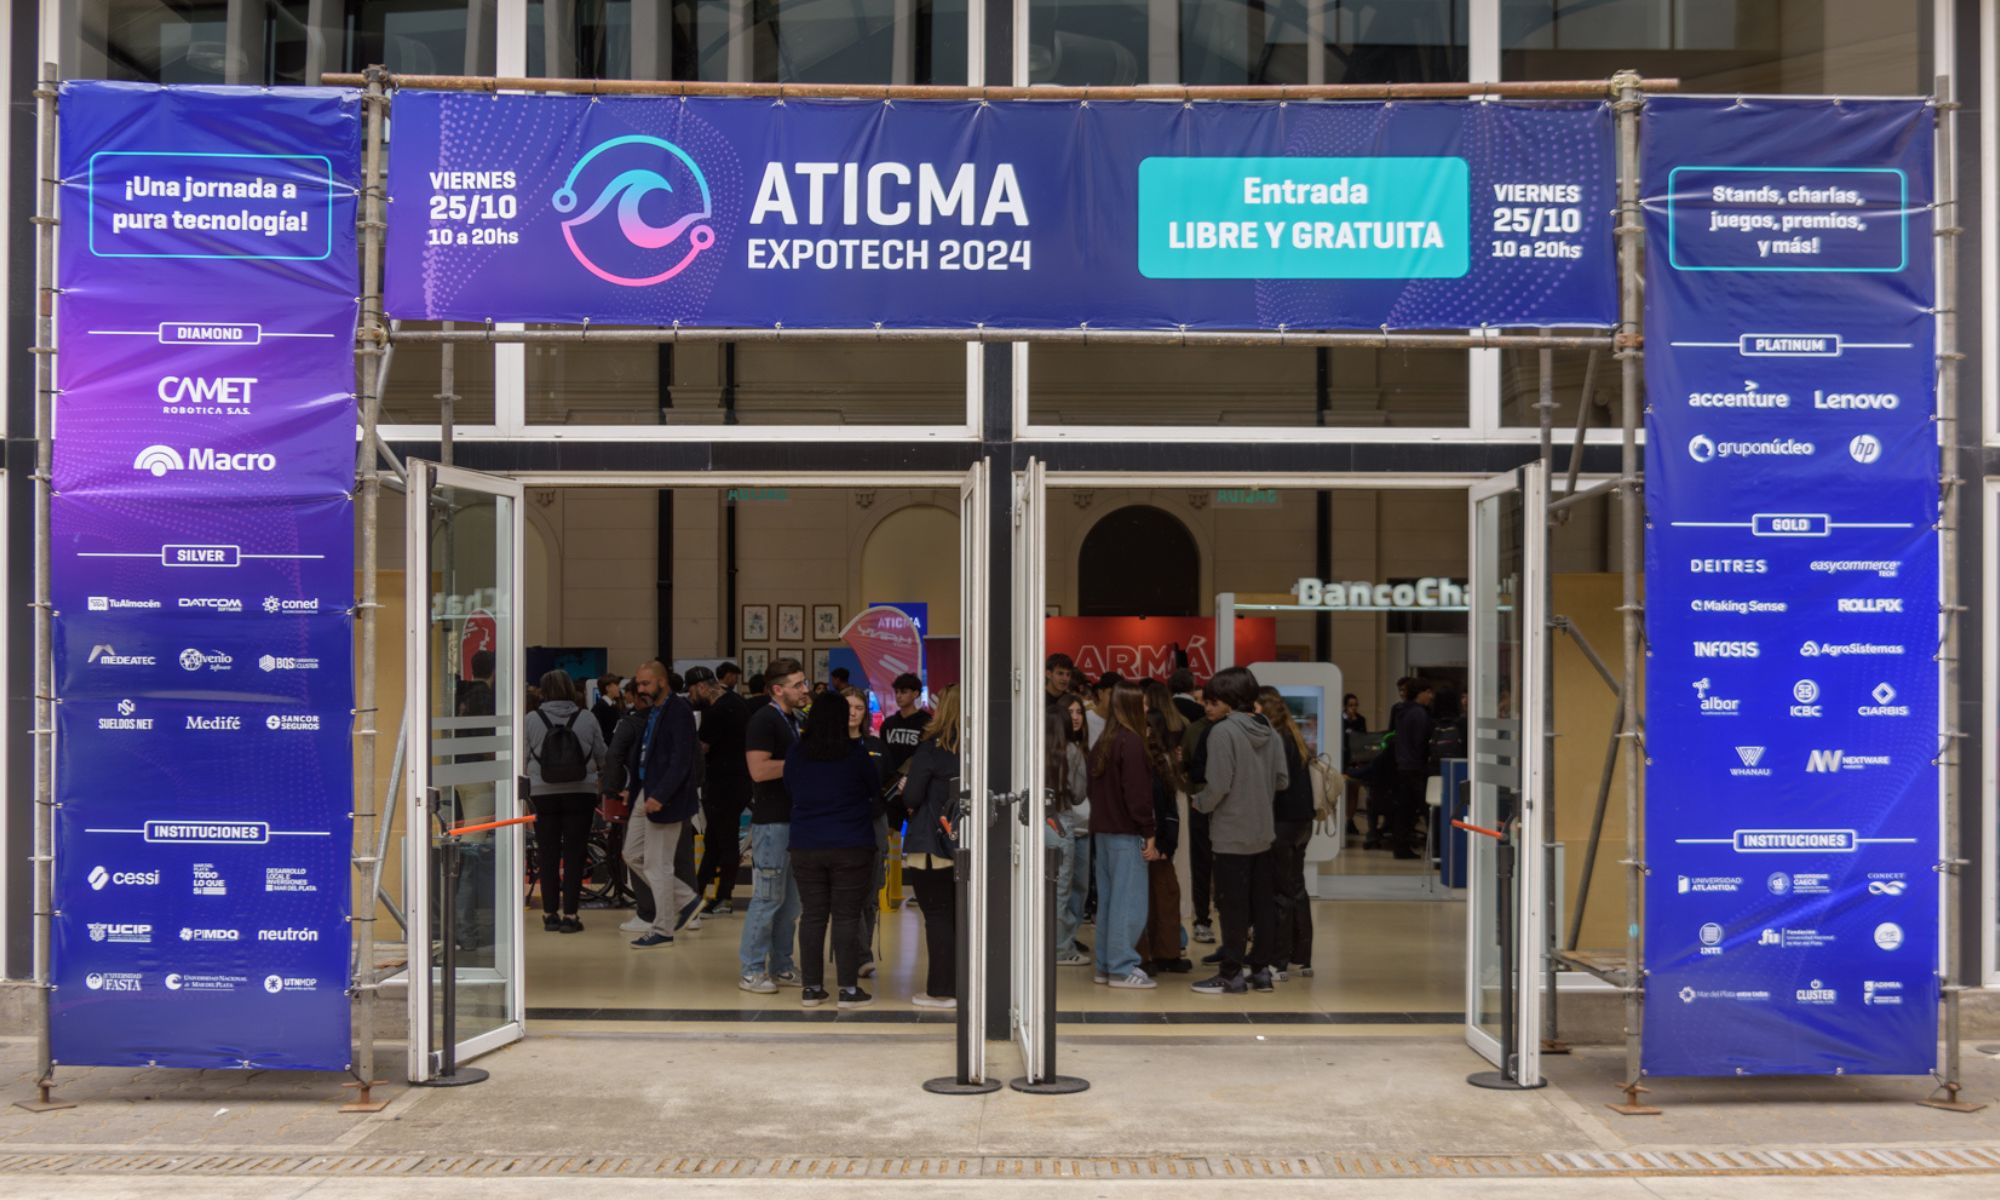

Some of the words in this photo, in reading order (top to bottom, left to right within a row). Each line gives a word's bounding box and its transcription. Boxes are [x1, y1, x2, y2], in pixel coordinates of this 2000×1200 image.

[429, 171, 517, 190] VIERNES
[125, 176, 181, 200] ¡Una
[183, 177, 278, 202] jornada
[282, 182, 297, 199] a
[749, 161, 1030, 226] ATICMA
[1244, 176, 1369, 205] Entrada
[1494, 184, 1581, 203] VIERNES
[1712, 185, 1787, 205] Stands,
[1788, 185, 1866, 206] charlas,
[429, 194, 518, 223] 25/10
[113, 213, 168, 234] pura
[172, 210, 308, 236] tecnología!
[1492, 208, 1581, 237] 25/10
[1709, 210, 1781, 232] juegos,
[1782, 212, 1867, 232] premios,
[428, 229, 453, 245] 10
[456, 232, 468, 245] a
[471, 228, 519, 245] 20hs
[1169, 221, 1258, 249] LIBRE
[1264, 221, 1286, 249] Y
[1291, 221, 1444, 249] GRATUITA
[1491, 242, 1516, 258] 10
[1519, 245, 1531, 258] a
[1533, 241, 1582, 258] 20hs
[1757, 240, 1771, 257] y
[1772, 236, 1820, 254] más!
[748, 239, 929, 270] EXPOTECH
[940, 239, 1032, 271] 2024
[177, 327, 242, 341] DIAMOND
[1756, 339, 1826, 351] PLATINUM
[158, 377, 258, 404] CAMET
[1689, 389, 1790, 408] accenture
[1814, 390, 1899, 409] Lenovo
[163, 406, 222, 415] ROBOTICA
[1718, 438, 1815, 457] gruponúcleo
[1852, 435, 1877, 462] hp
[189, 448, 276, 471] Macro
[1772, 518, 1810, 531] GOLD
[177, 550, 225, 562] SILVER
[1691, 559, 1768, 573] DEITRES
[1810, 560, 1897, 574] easycommerce
[178, 598, 242, 608] DATCOM
[282, 597, 318, 609] coned
[1704, 600, 1748, 614] Making
[1749, 601, 1787, 612] Sense
[1838, 599, 1903, 612] ROLLPIX
[1821, 643, 1903, 657] AgroSistemas
[101, 656, 156, 665] MEDEATEC
[1700, 697, 1740, 710] albor
[1790, 705, 1822, 717] ICBC
[99, 718, 135, 730] SUELDOS
[185, 716, 241, 730] Medifé
[281, 715, 320, 723] SANCOR
[154, 826, 259, 839] INSTITUCIONES
[1744, 834, 1847, 847] INSTITUCIONES
[113, 870, 160, 885] cessi
[107, 924, 152, 934] UCIP
[258, 928, 318, 941] neutrón
[105, 979, 142, 991] FASTA
[1796, 989, 1835, 1000] CLUSTER
